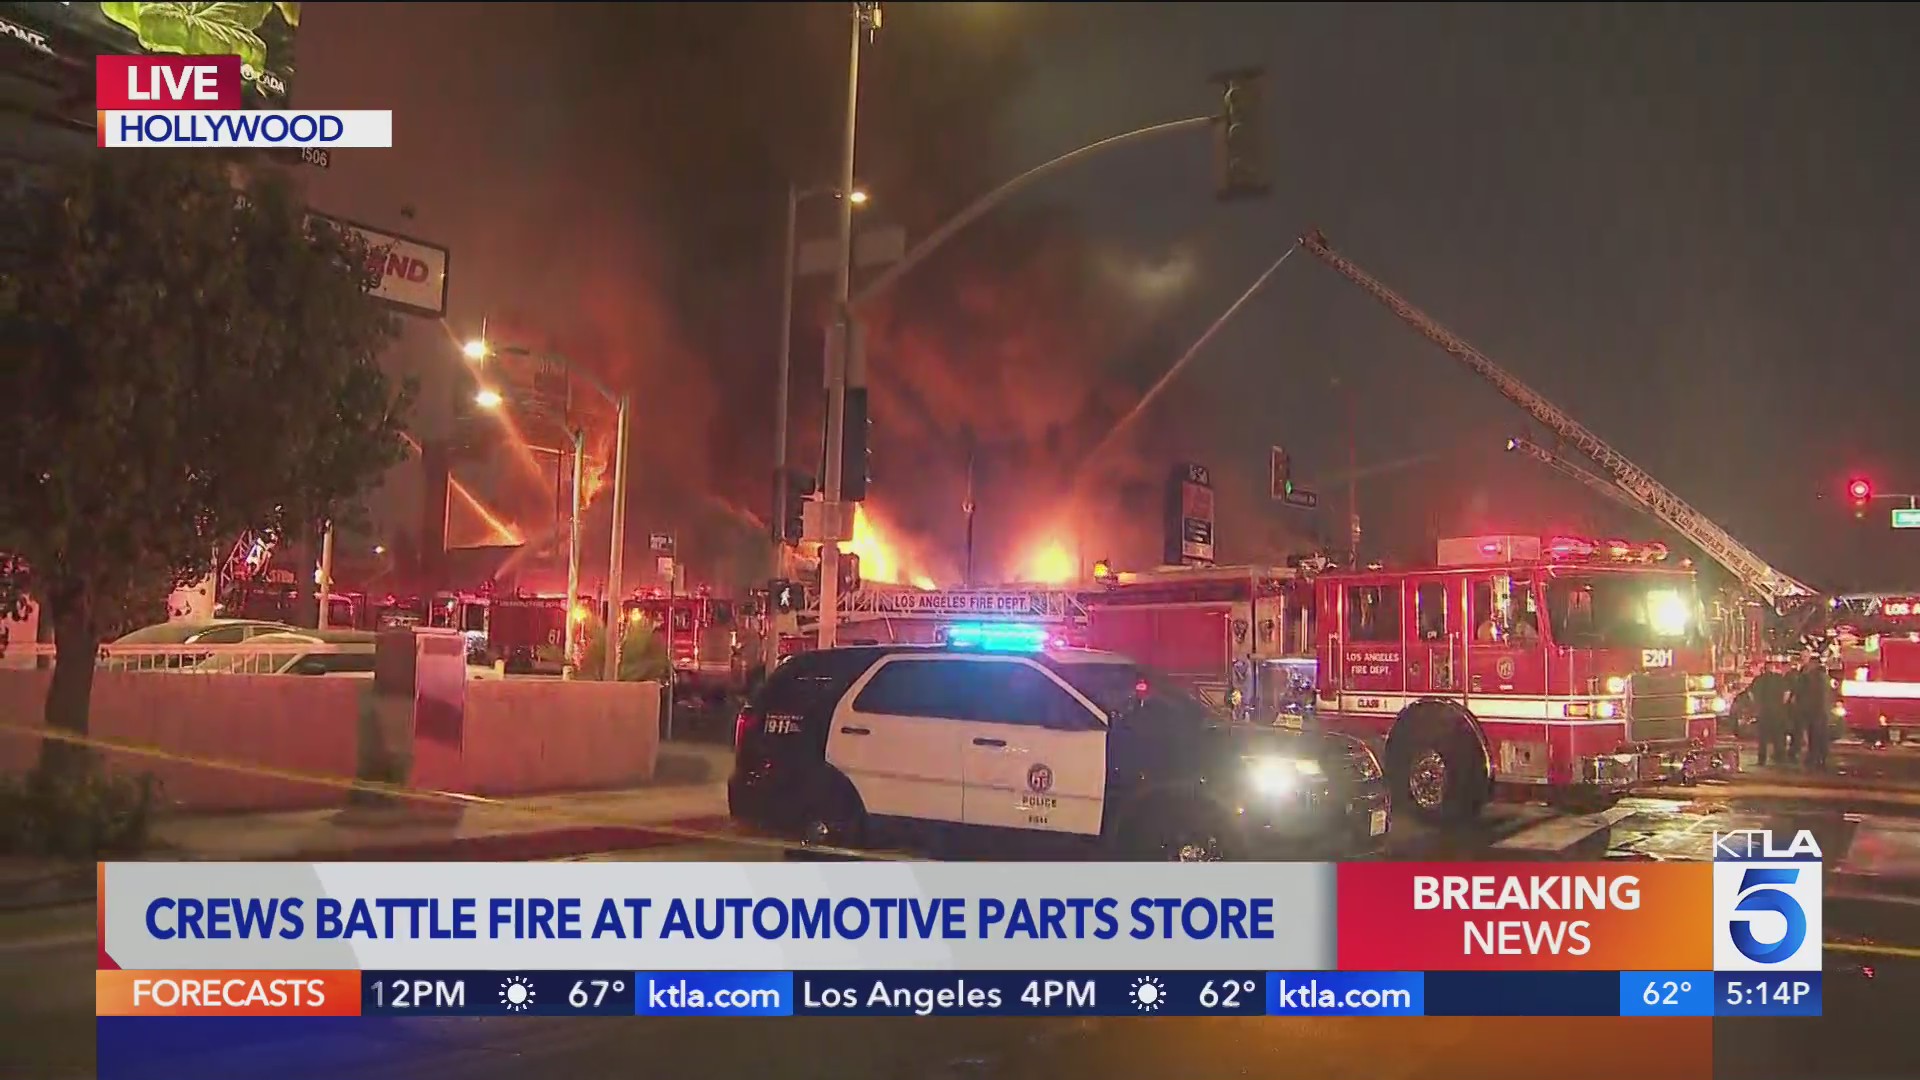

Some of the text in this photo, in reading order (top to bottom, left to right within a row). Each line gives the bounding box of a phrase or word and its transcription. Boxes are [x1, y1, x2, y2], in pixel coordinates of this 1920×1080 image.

[301, 147, 328, 167] 1506
[894, 595, 916, 608] LOS
[919, 595, 967, 609] ANGELES
[969, 596, 994, 610] FIRE
[1346, 652, 1400, 662] LOS ANGELES
[1643, 650, 1674, 667] E201
[1351, 665, 1368, 675] FIRE
[1022, 795, 1057, 809] POLICE
